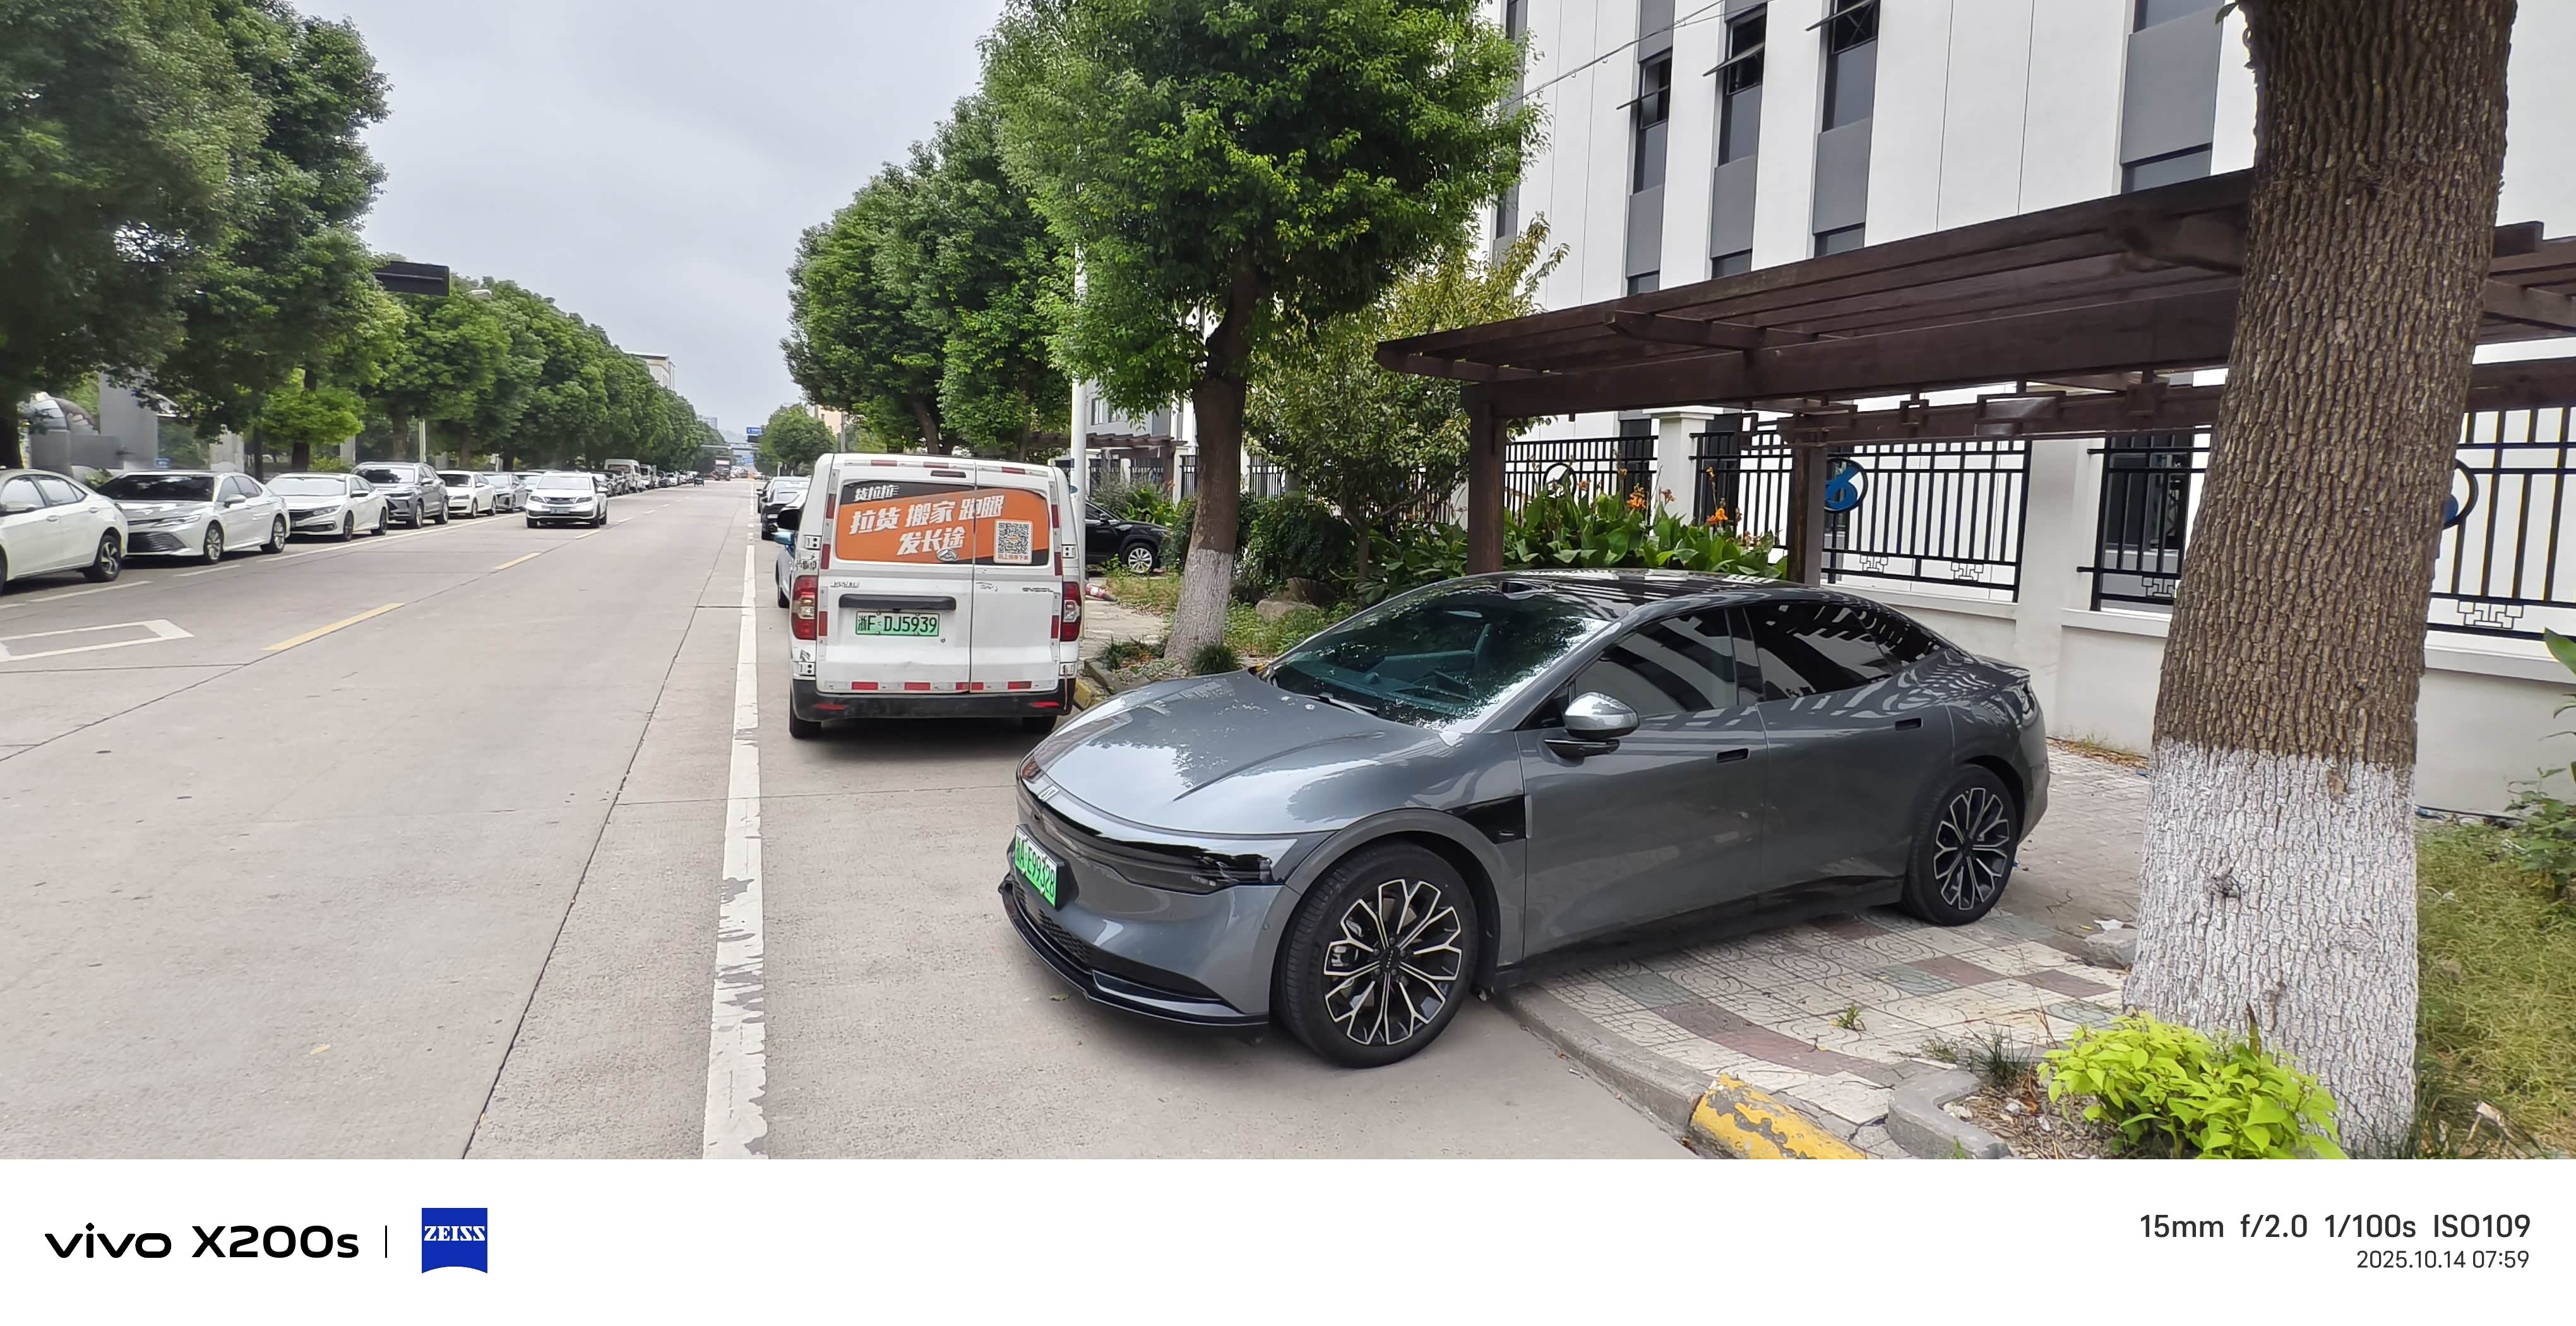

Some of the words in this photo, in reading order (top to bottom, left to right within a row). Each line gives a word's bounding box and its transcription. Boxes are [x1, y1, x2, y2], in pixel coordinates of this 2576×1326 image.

[854, 485, 900, 502] 货拉拉
[849, 506, 902, 535] 拉货
[904, 501, 956, 528] 搬家
[958, 495, 1005, 521] 跑腿
[897, 526, 965, 556] 发长途
